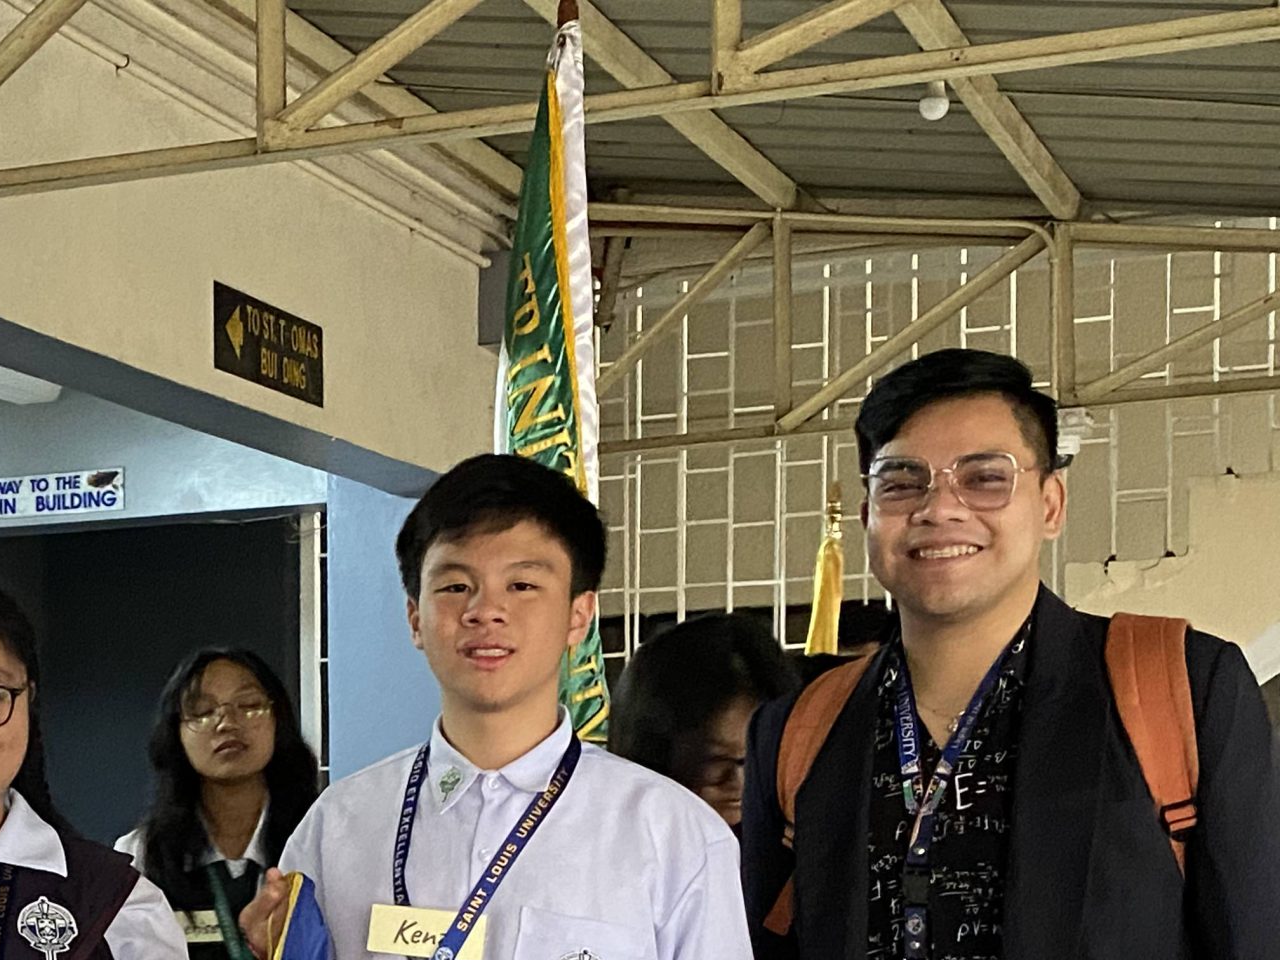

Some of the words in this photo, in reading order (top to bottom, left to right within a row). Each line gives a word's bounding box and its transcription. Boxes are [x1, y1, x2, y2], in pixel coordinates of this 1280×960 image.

[246, 304, 260, 336] TO
[279, 319, 318, 360] TOMAS
[261, 347, 306, 390] BUIDING
[30, 478, 49, 492] TO
[55, 475, 81, 490] THE
[35, 490, 118, 512] BUILDING
[456, 887, 488, 932] SAINT
[486, 842, 518, 884] LOUIS
[516, 768, 570, 839] UNIVERSITY
[393, 919, 447, 945] Ken
